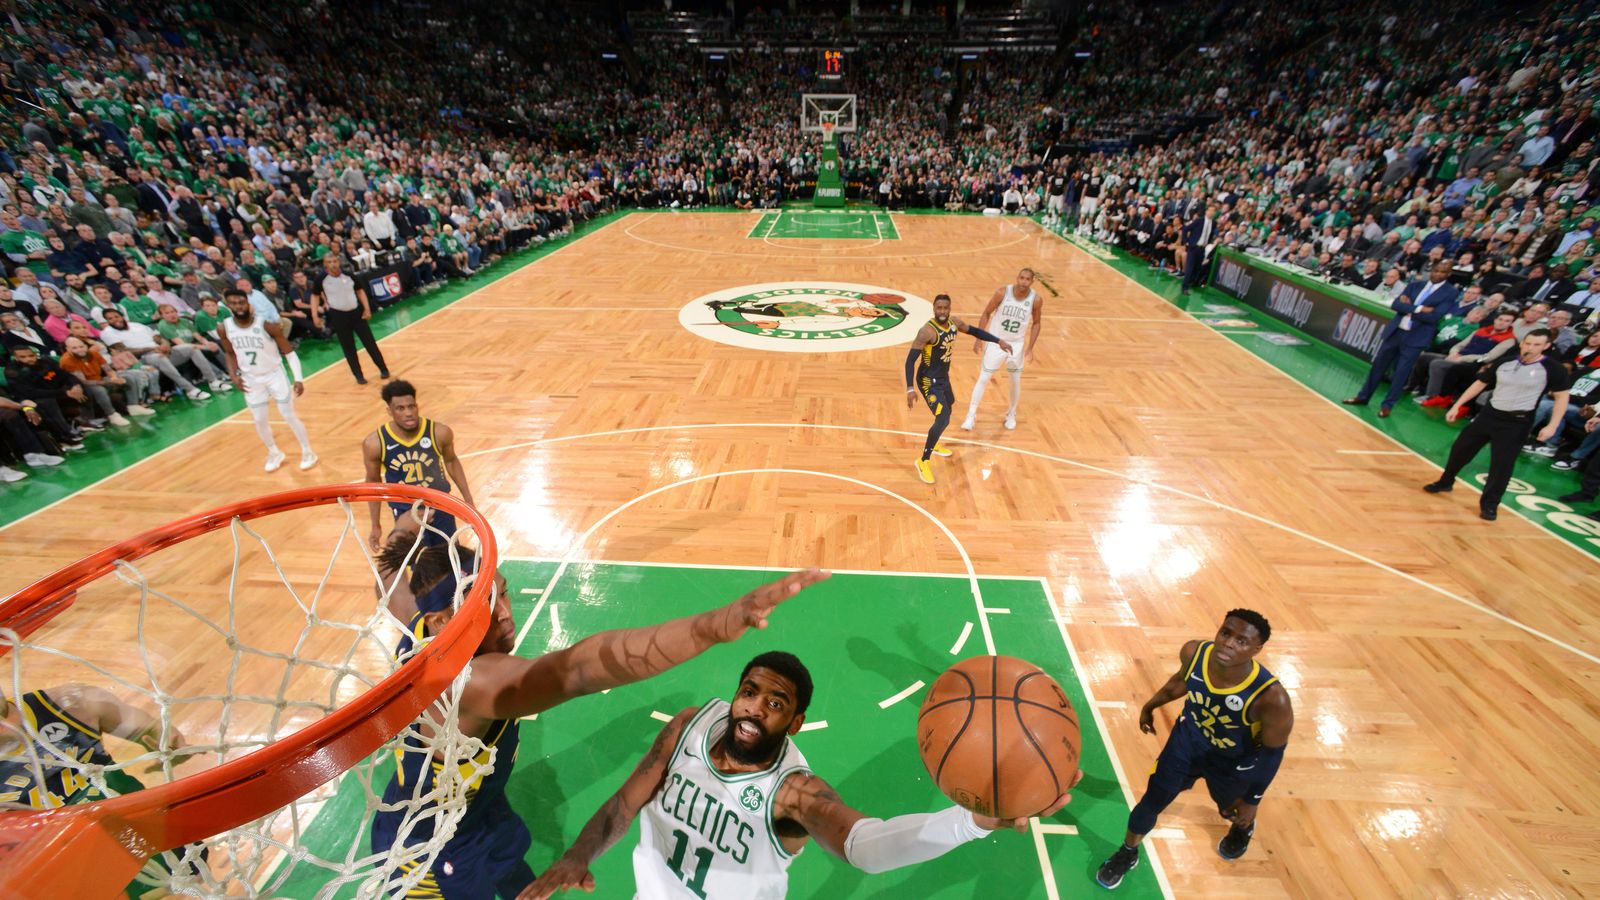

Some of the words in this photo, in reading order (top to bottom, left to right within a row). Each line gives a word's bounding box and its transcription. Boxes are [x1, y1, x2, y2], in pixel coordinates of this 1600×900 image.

[752, 287, 861, 298] BOSTON
[1274, 284, 1299, 317] NBA
[1292, 291, 1314, 328] App
[759, 323, 884, 339] CELTICS
[1001, 319, 1021, 334] 42
[1342, 313, 1378, 352] NBA
[245, 351, 257, 366] 7
[389, 451, 434, 471] INDIANA
[402, 462, 424, 483] 21
[661, 772, 755, 865] CELTICS
[666, 828, 715, 900] 11
